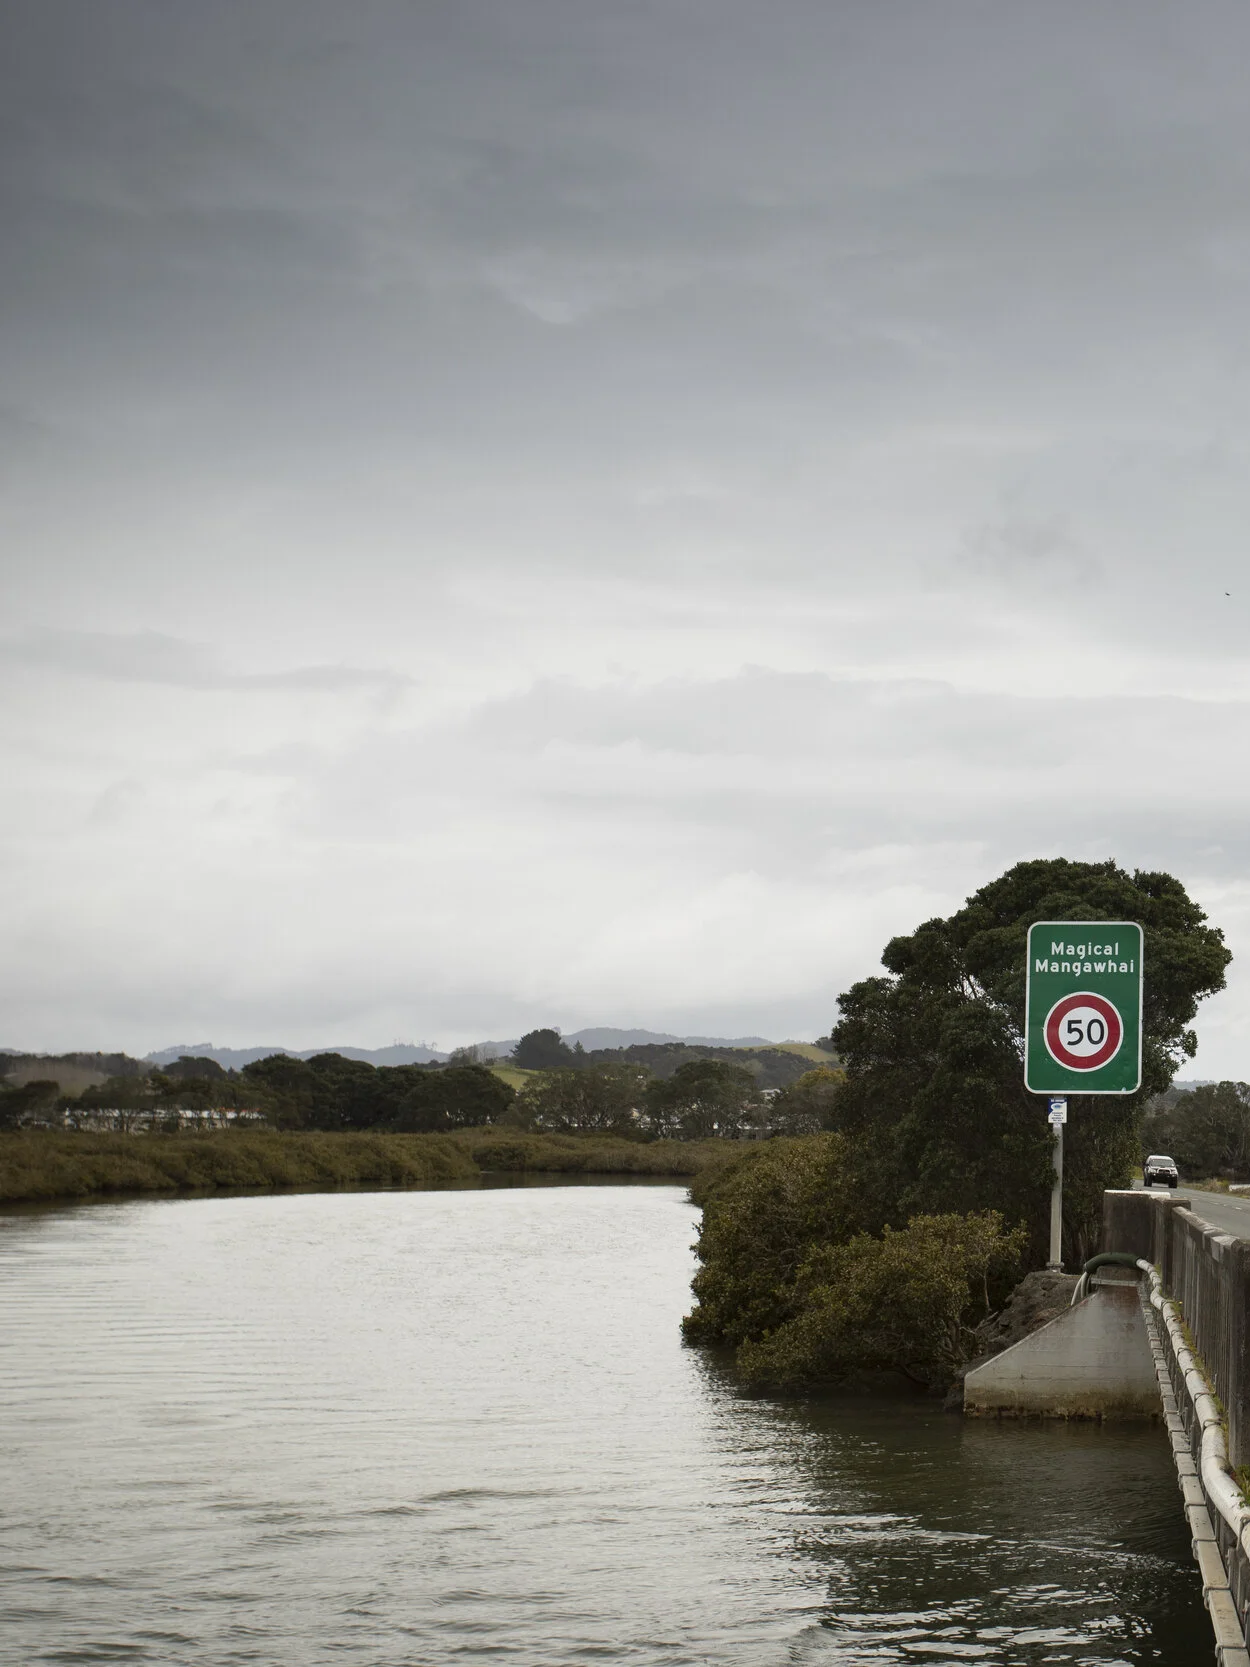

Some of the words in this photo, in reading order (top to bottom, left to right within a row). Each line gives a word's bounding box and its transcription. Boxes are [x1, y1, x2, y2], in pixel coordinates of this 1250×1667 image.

[1051, 942, 1119, 959] Magical
[1035, 959, 1134, 977] Mangawhai
[1066, 1019, 1105, 1046] 50
